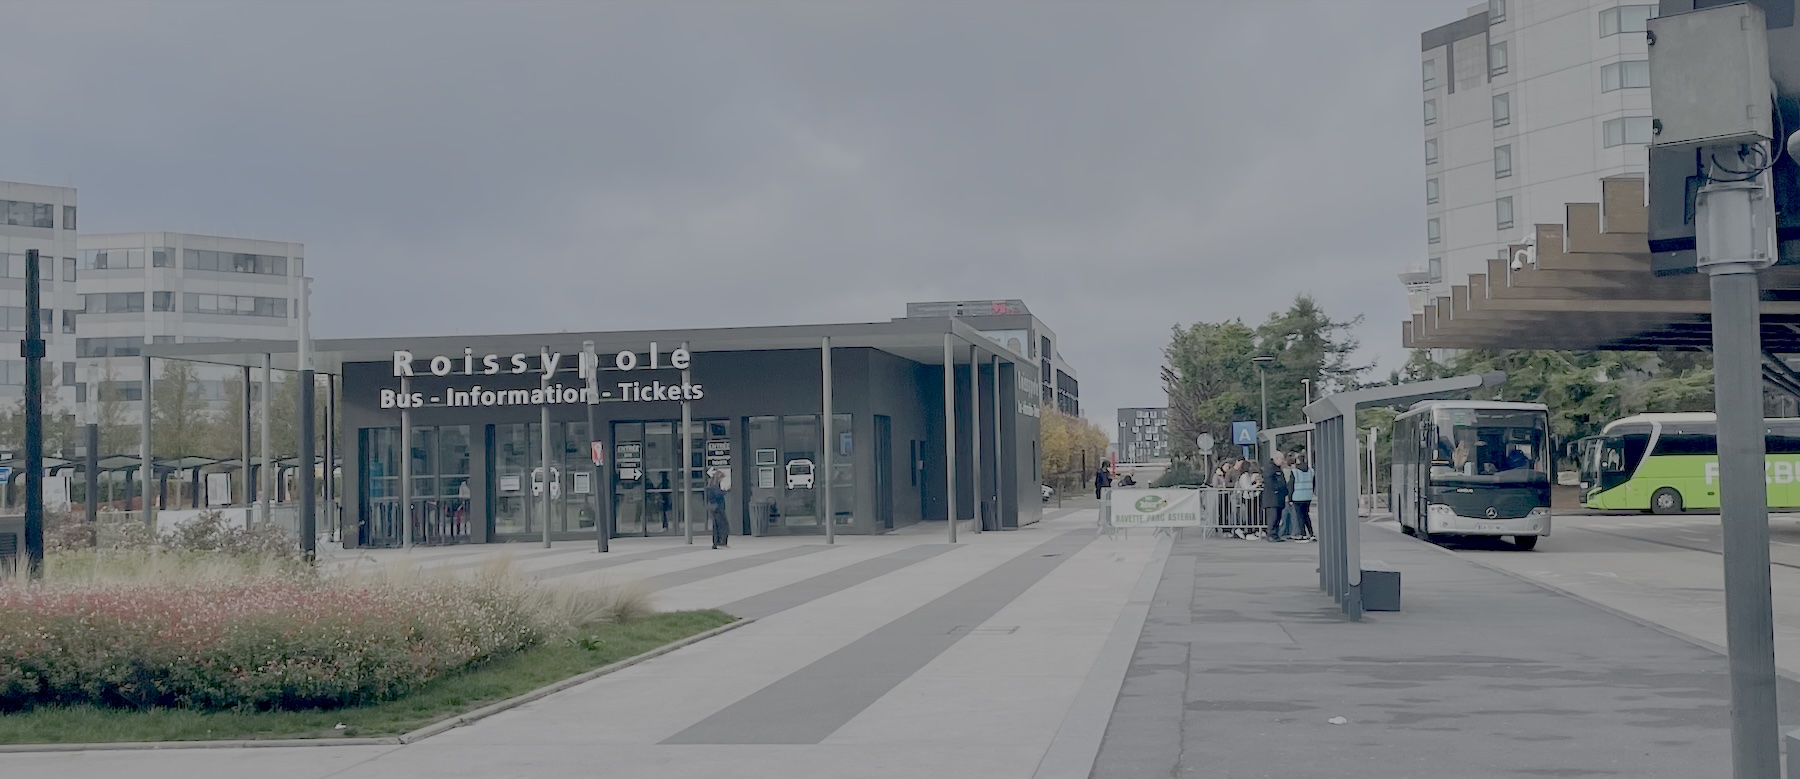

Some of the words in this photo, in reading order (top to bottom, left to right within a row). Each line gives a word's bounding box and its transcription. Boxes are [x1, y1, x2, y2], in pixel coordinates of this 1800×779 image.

[380, 389, 423, 408] Bus
[618, 381, 704, 402] Tickets
[1239, 428, 1251, 441] A
[1115, 514, 1144, 523] NAVETTE
[1146, 513, 1165, 522] PARC
